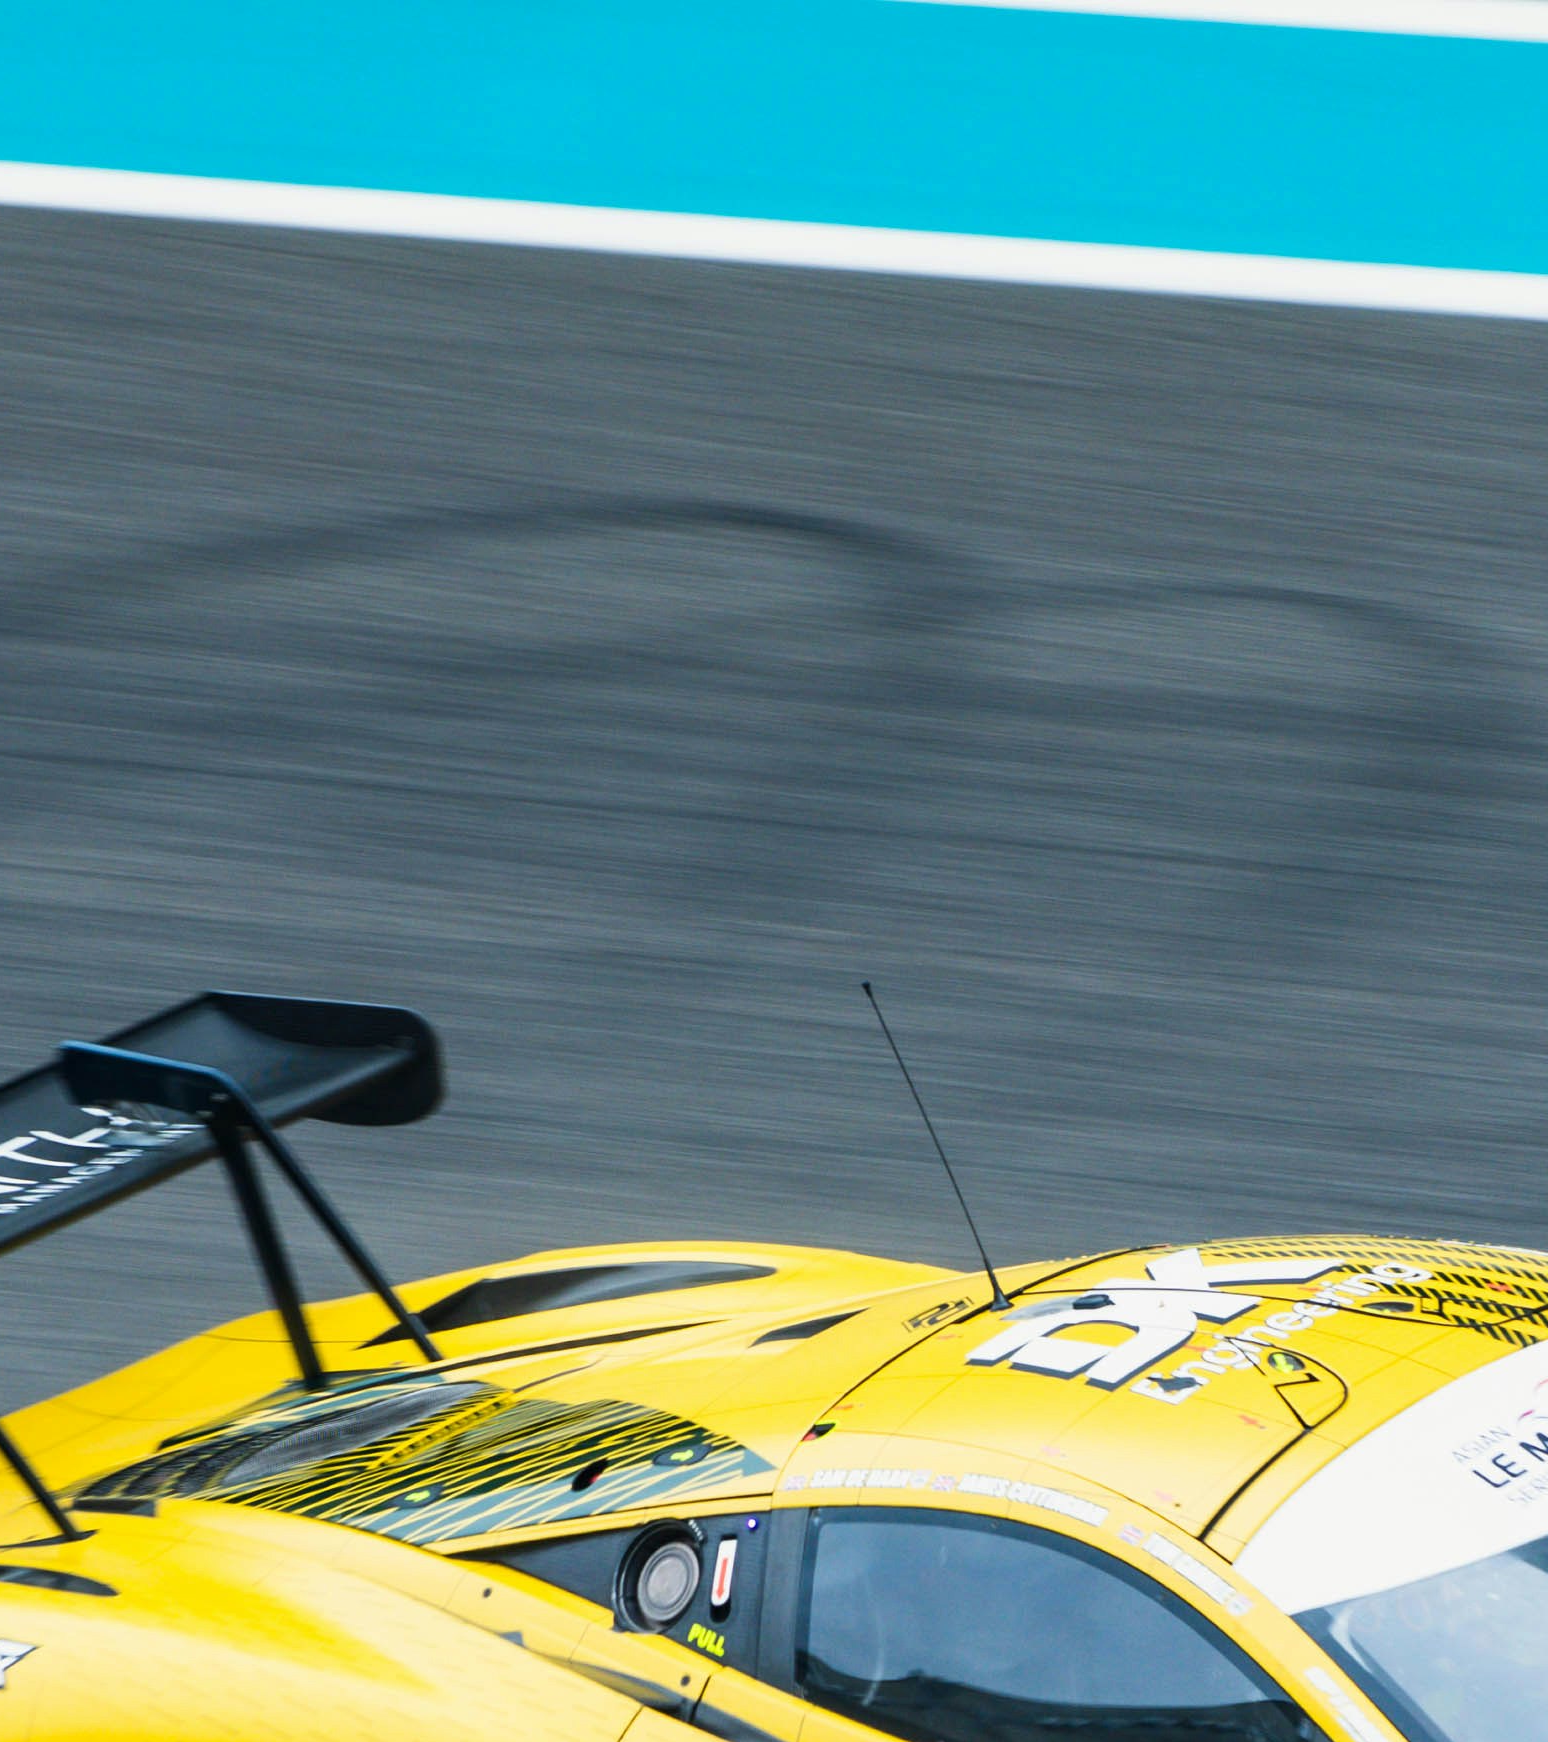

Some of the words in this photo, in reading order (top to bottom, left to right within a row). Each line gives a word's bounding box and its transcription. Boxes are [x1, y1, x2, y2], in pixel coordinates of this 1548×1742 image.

[966, 1248, 1346, 1392] DK
[1130, 1260, 1433, 1406] Engineering
[1472, 1453, 1528, 1488] LE
[687, 1623, 725, 1657] PULL
